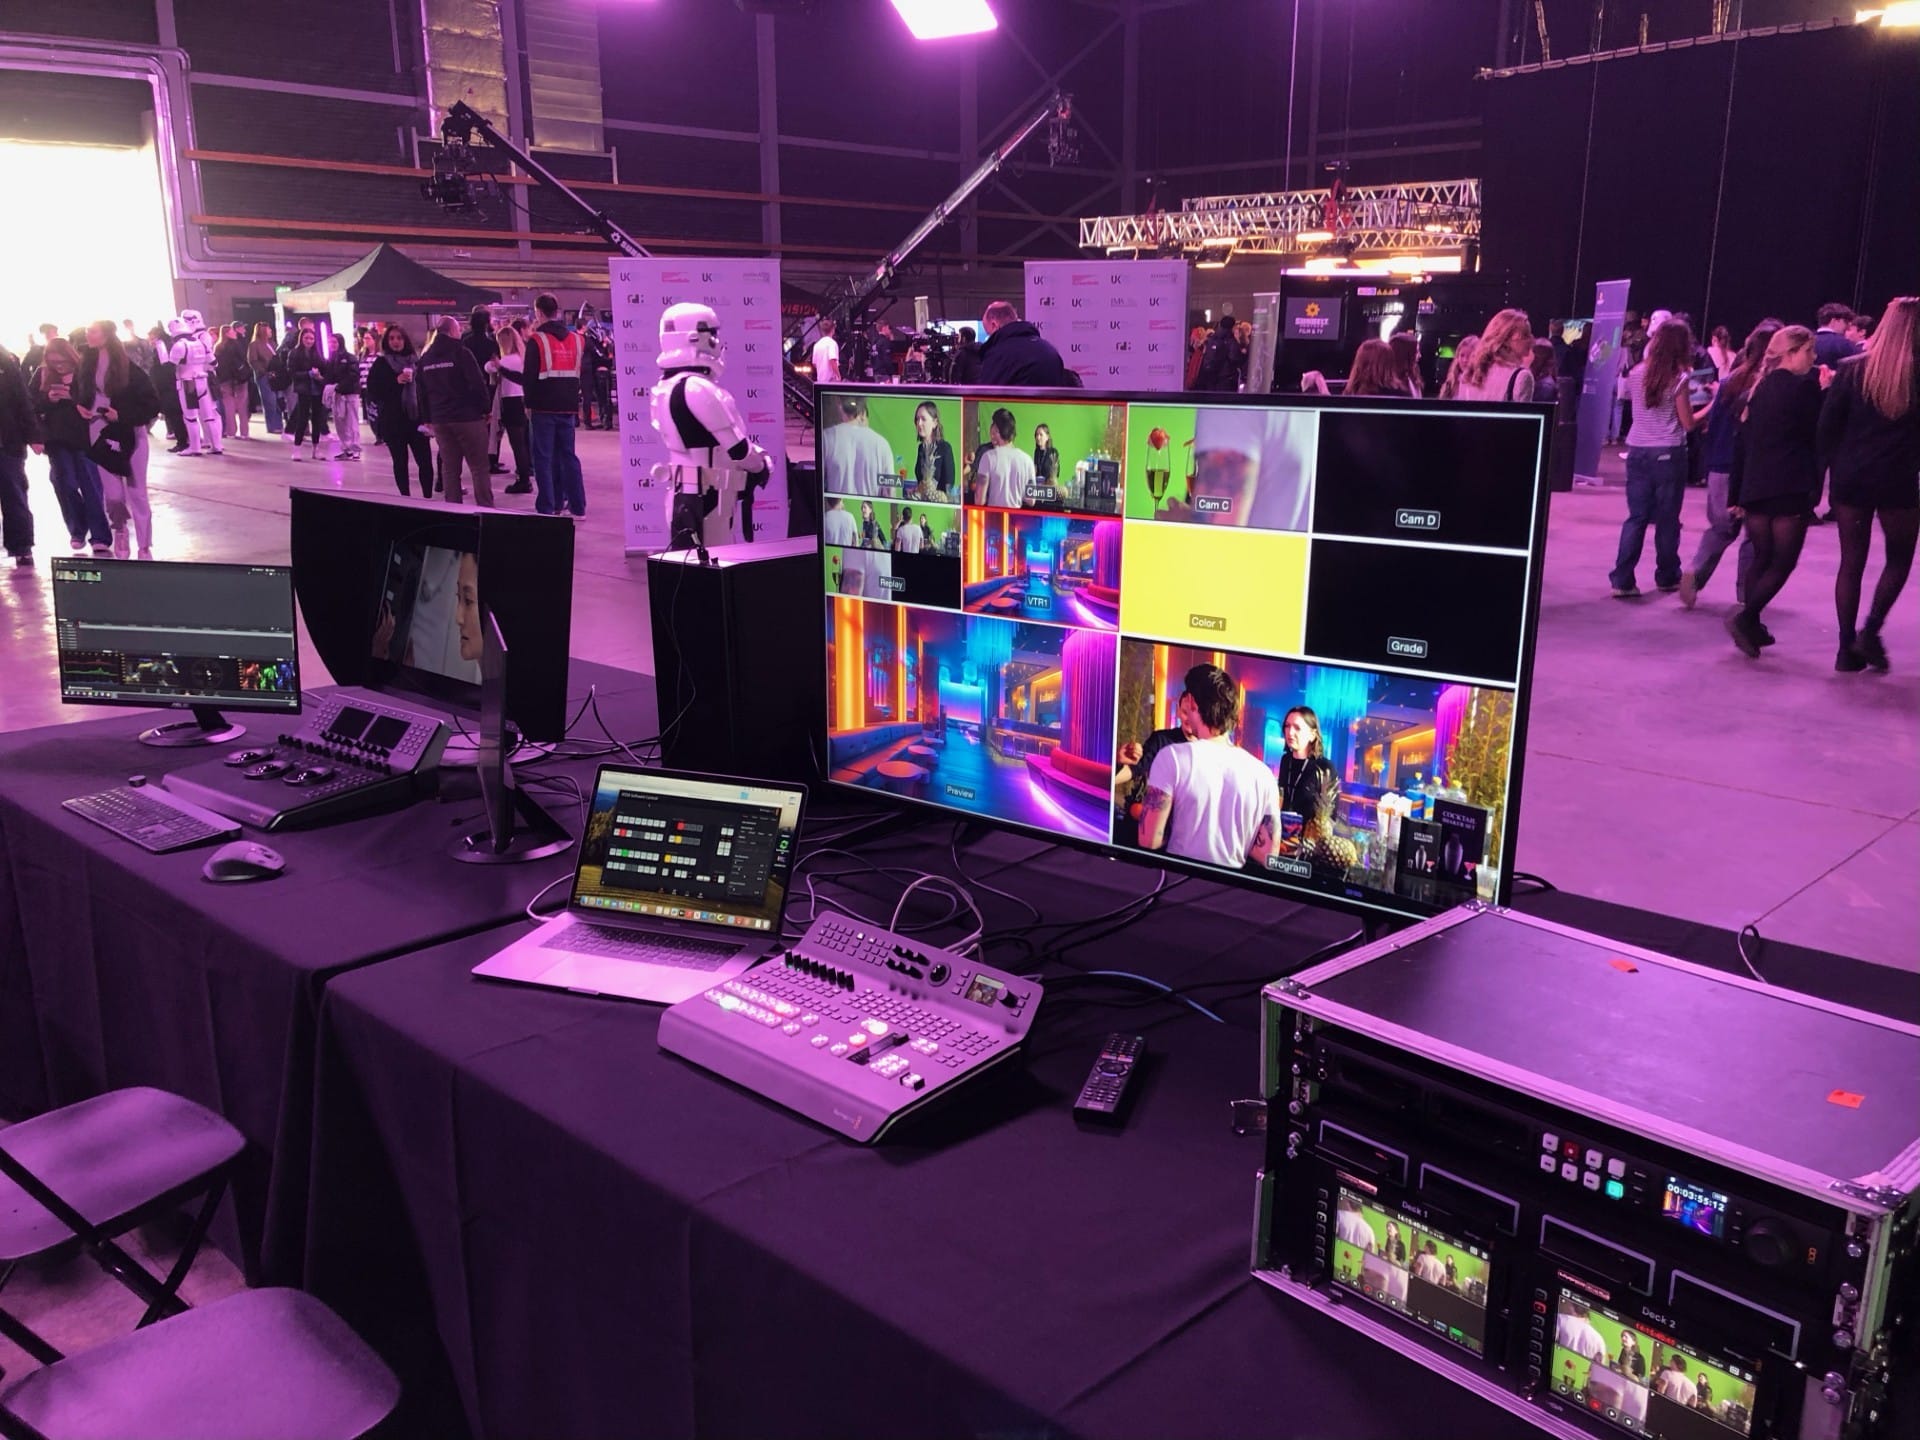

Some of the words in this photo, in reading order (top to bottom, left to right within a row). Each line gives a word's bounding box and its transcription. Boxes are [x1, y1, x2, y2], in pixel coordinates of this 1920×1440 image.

[878, 476, 894, 485] Cam
[896, 477, 902, 486] A
[1026, 487, 1046, 497] Cam
[1047, 488, 1053, 498] B
[1198, 499, 1220, 510] Cam
[1222, 500, 1230, 511] C
[1400, 512, 1424, 525] Cam
[1427, 514, 1436, 526] D
[880, 578, 904, 590] Replay
[1028, 596, 1048, 608] VTR1
[1191, 616, 1216, 628] Color
[1218, 620, 1223, 629] 1
[1391, 640, 1424, 654] Grade
[946, 785, 974, 798] Preview
[1268, 856, 1308, 875] Program
[1666, 1184, 1725, 1212] 00:03:55:12
[1402, 1200, 1422, 1216] Deck
[1424, 1210, 1428, 1218] 1
[1642, 1306, 1667, 1325] Deck
[1669, 1320, 1676, 1328] 2
